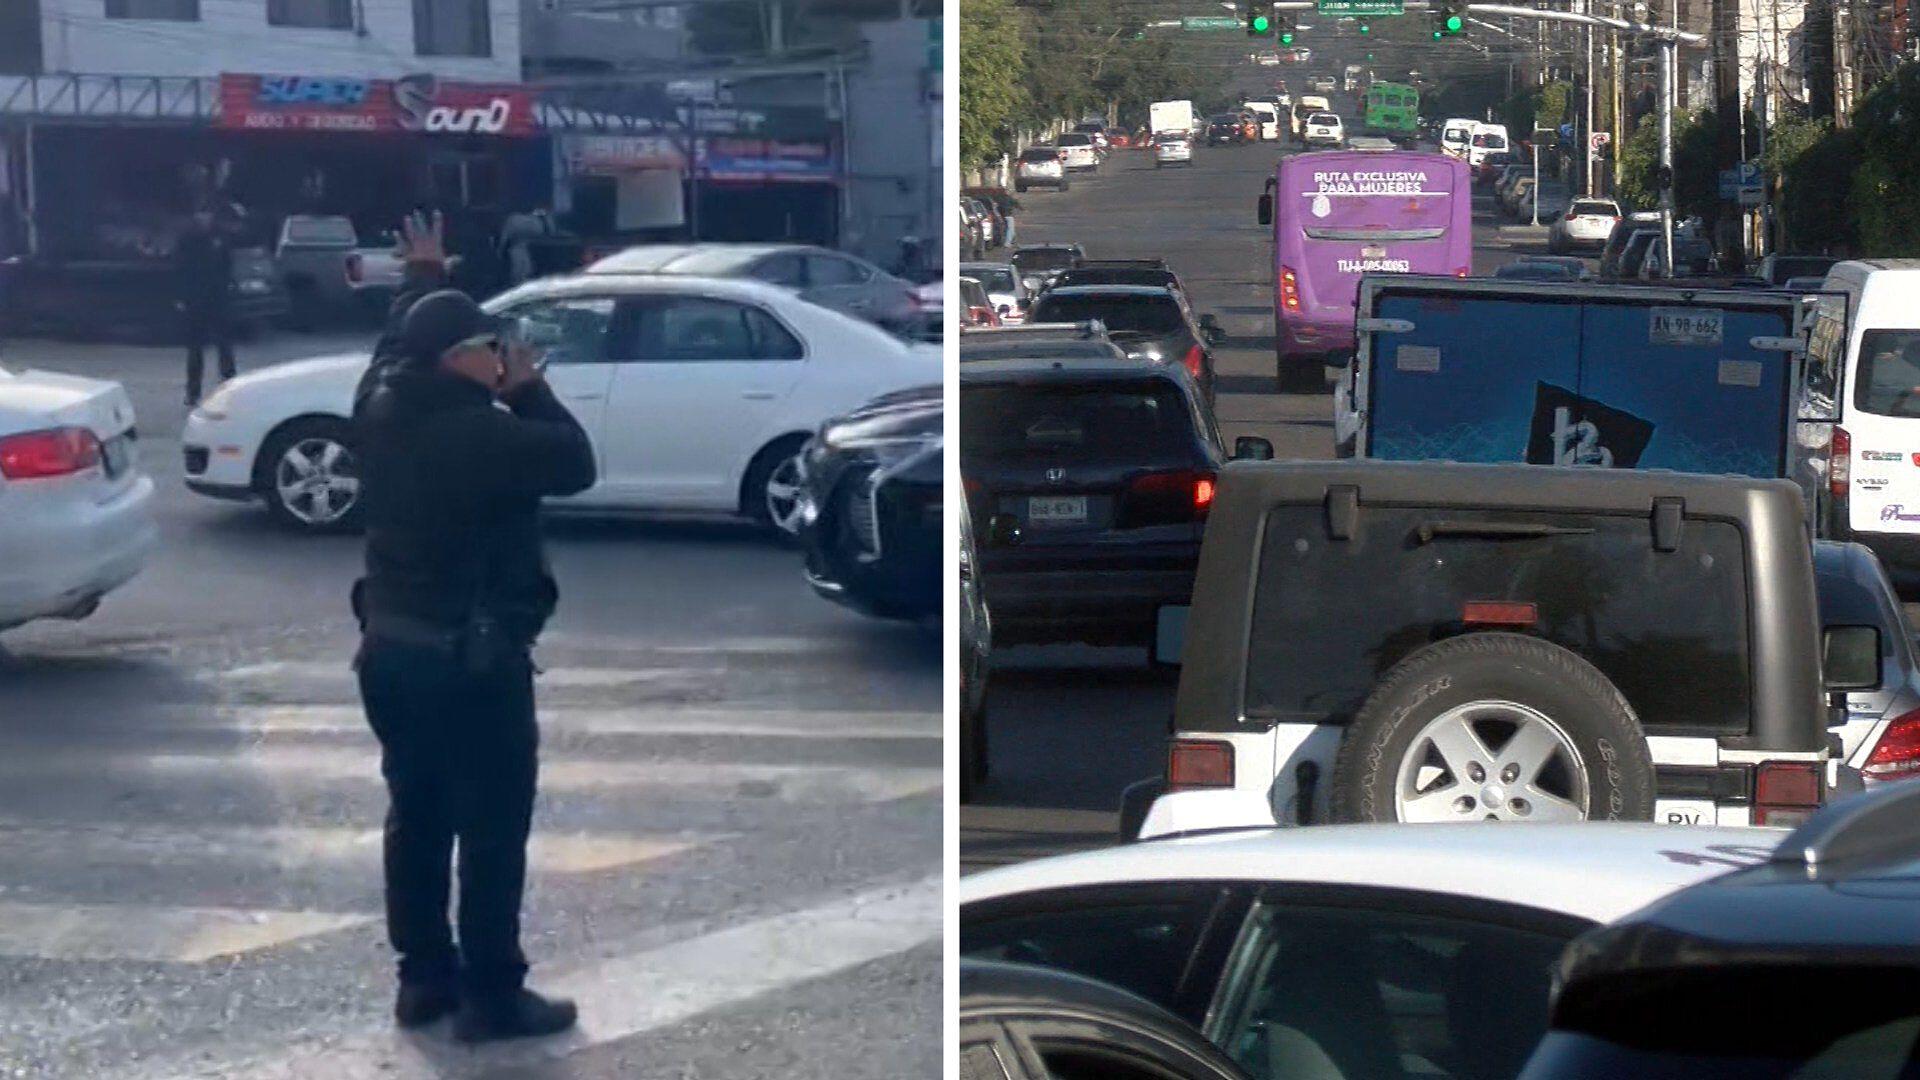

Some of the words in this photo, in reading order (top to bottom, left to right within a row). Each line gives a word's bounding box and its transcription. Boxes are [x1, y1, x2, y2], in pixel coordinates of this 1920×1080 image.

[259, 75, 364, 103] SUPER
[1314, 172, 1350, 182] RUTA
[1353, 172, 1427, 182] EXCLUSIVA
[1319, 182, 1356, 193] PARA
[1359, 182, 1422, 193] MUJERES
